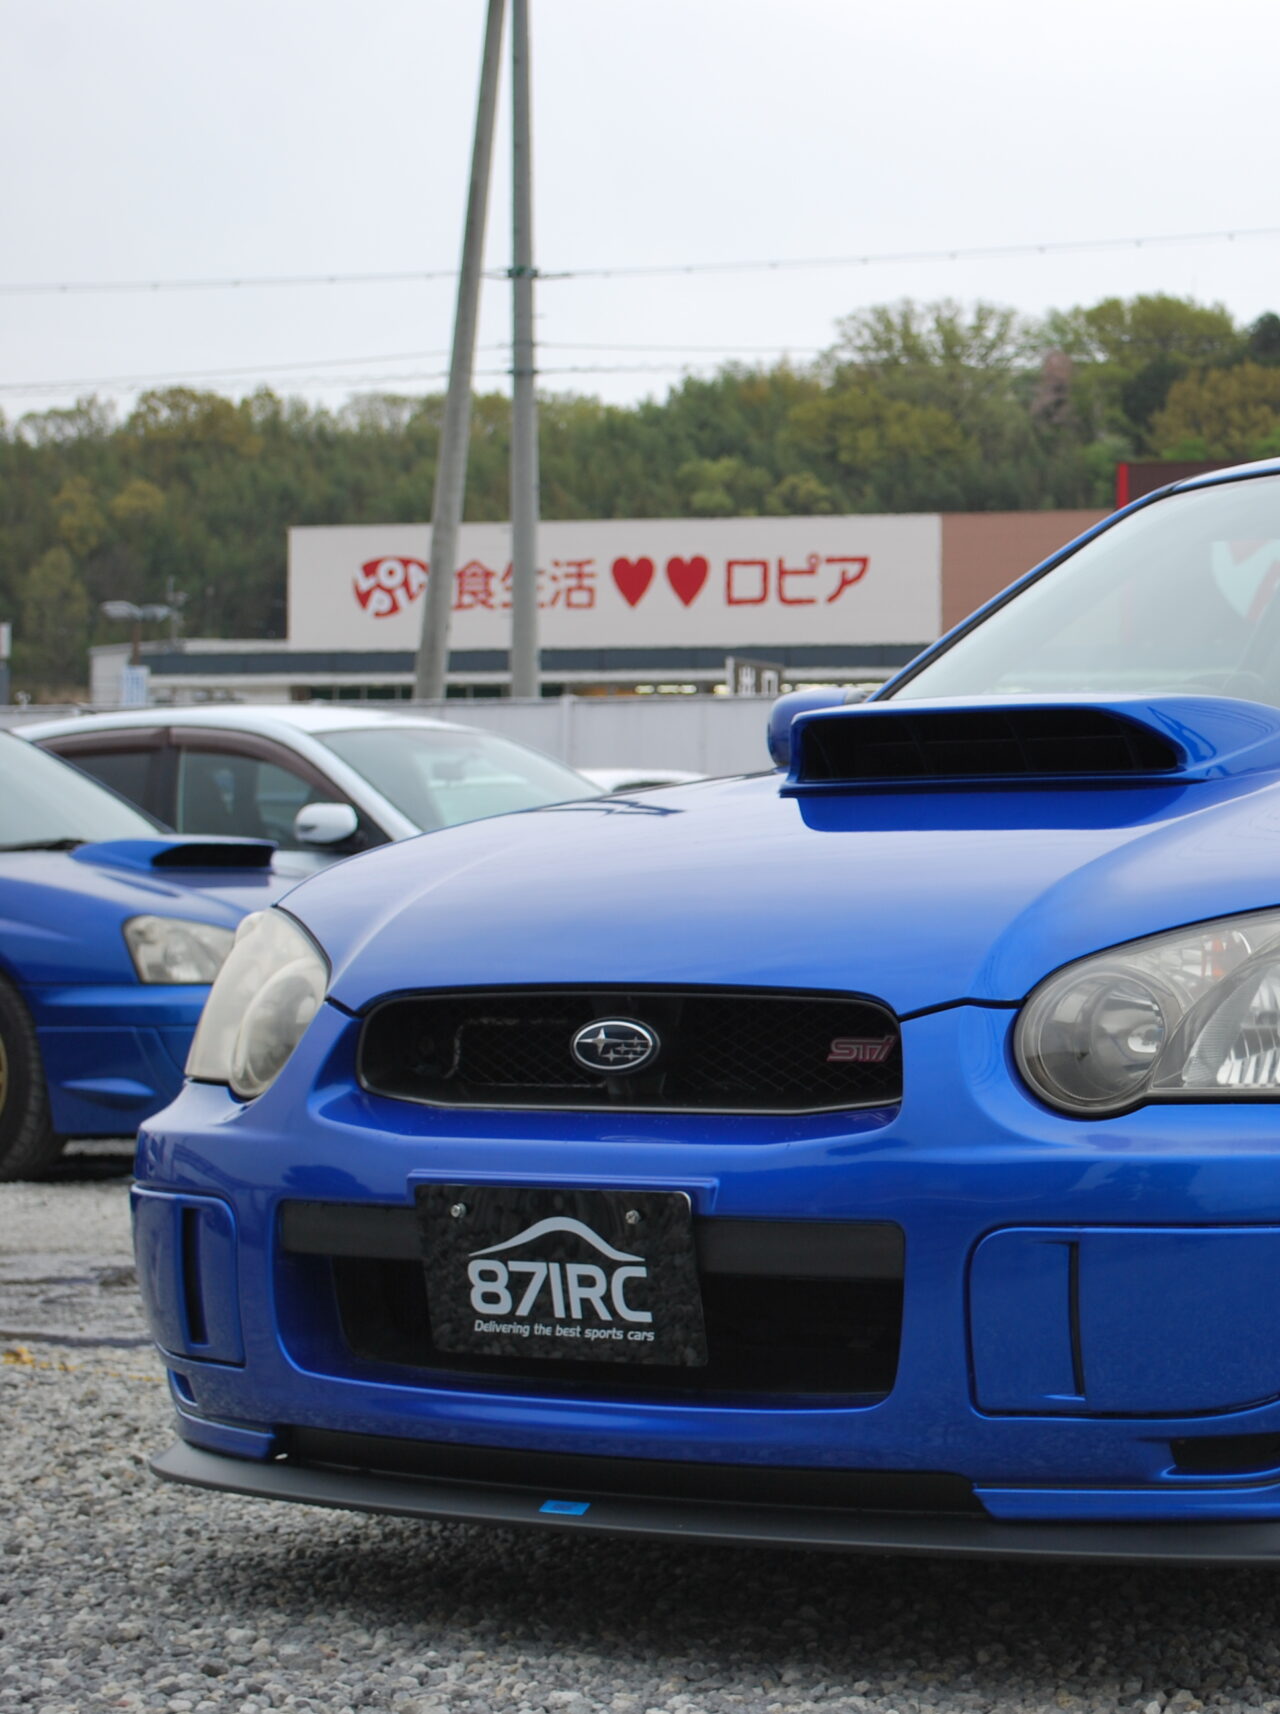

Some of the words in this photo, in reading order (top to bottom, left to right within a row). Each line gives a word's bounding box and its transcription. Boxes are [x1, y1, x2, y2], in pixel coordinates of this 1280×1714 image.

[726, 554, 869, 606] ロピア
[474, 1319, 530, 1337] Delivering
[533, 1323, 551, 1336] the
[555, 1324, 581, 1338] best
[584, 1327, 624, 1341] sports
[627, 1330, 655, 1342] cars
